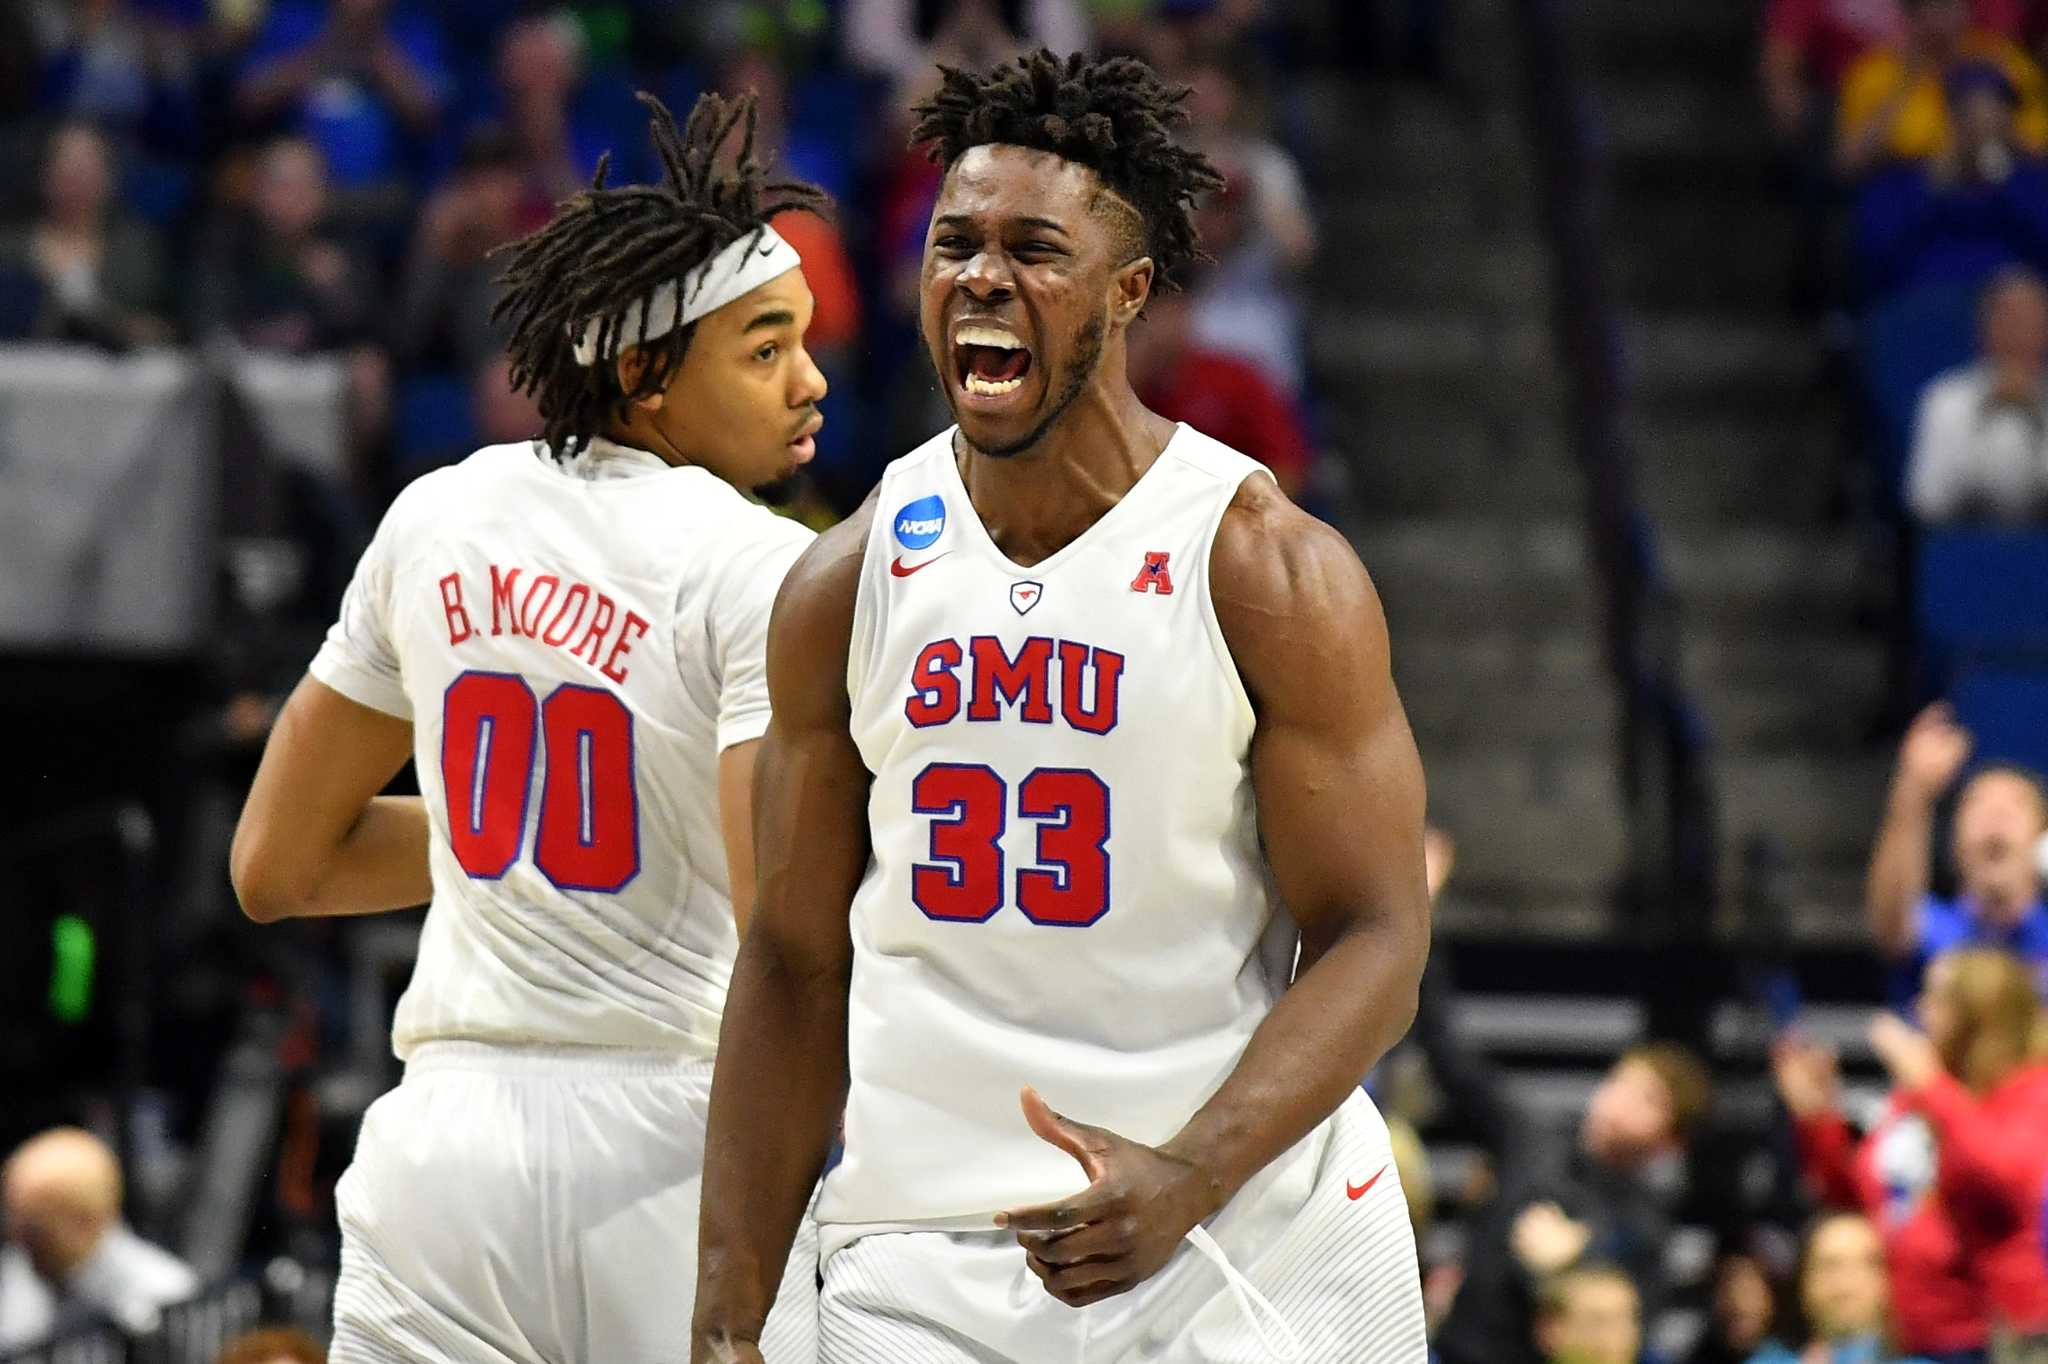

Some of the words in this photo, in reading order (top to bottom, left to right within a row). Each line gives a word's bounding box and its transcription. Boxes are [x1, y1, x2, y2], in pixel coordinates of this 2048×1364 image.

[490, 565, 650, 685] MOORE
[1130, 551, 1174, 595] A
[904, 635, 1125, 736] SMU
[441, 670, 642, 895] 00
[911, 762, 1112, 928] 33
